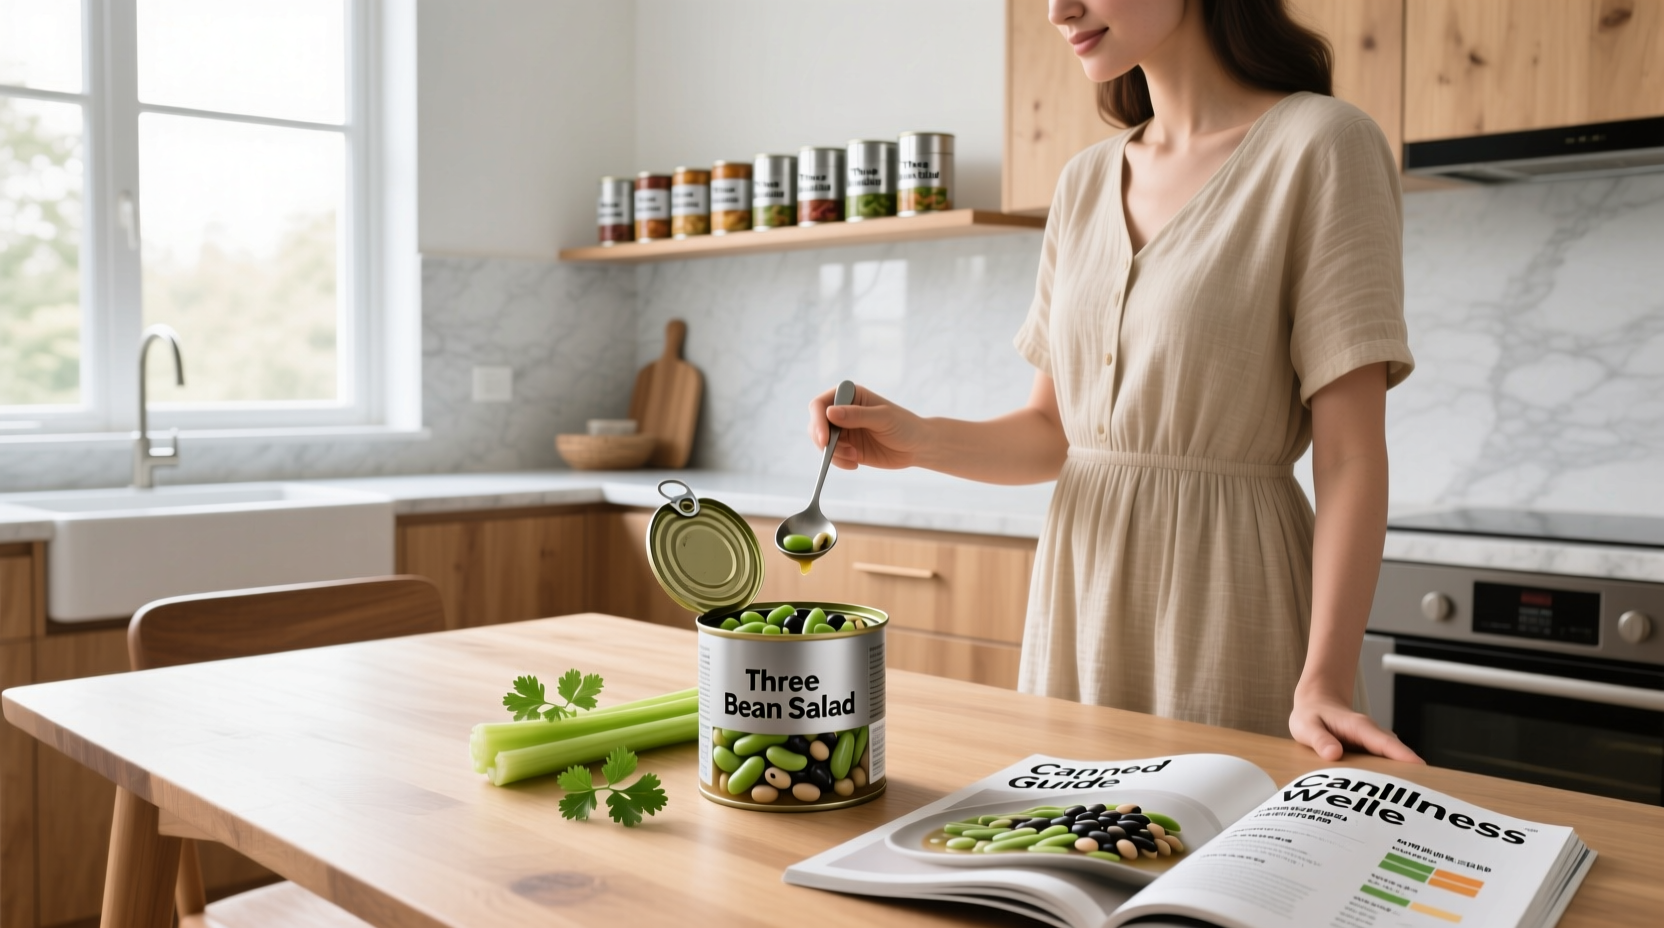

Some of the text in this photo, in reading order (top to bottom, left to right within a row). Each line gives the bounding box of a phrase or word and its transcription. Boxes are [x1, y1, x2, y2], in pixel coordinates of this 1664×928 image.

[746, 668, 819, 692] Three
[724, 691, 855, 719] Bean Salad
[1008, 775, 1120, 790] Guide
[1283, 788, 1406, 826] Welle
